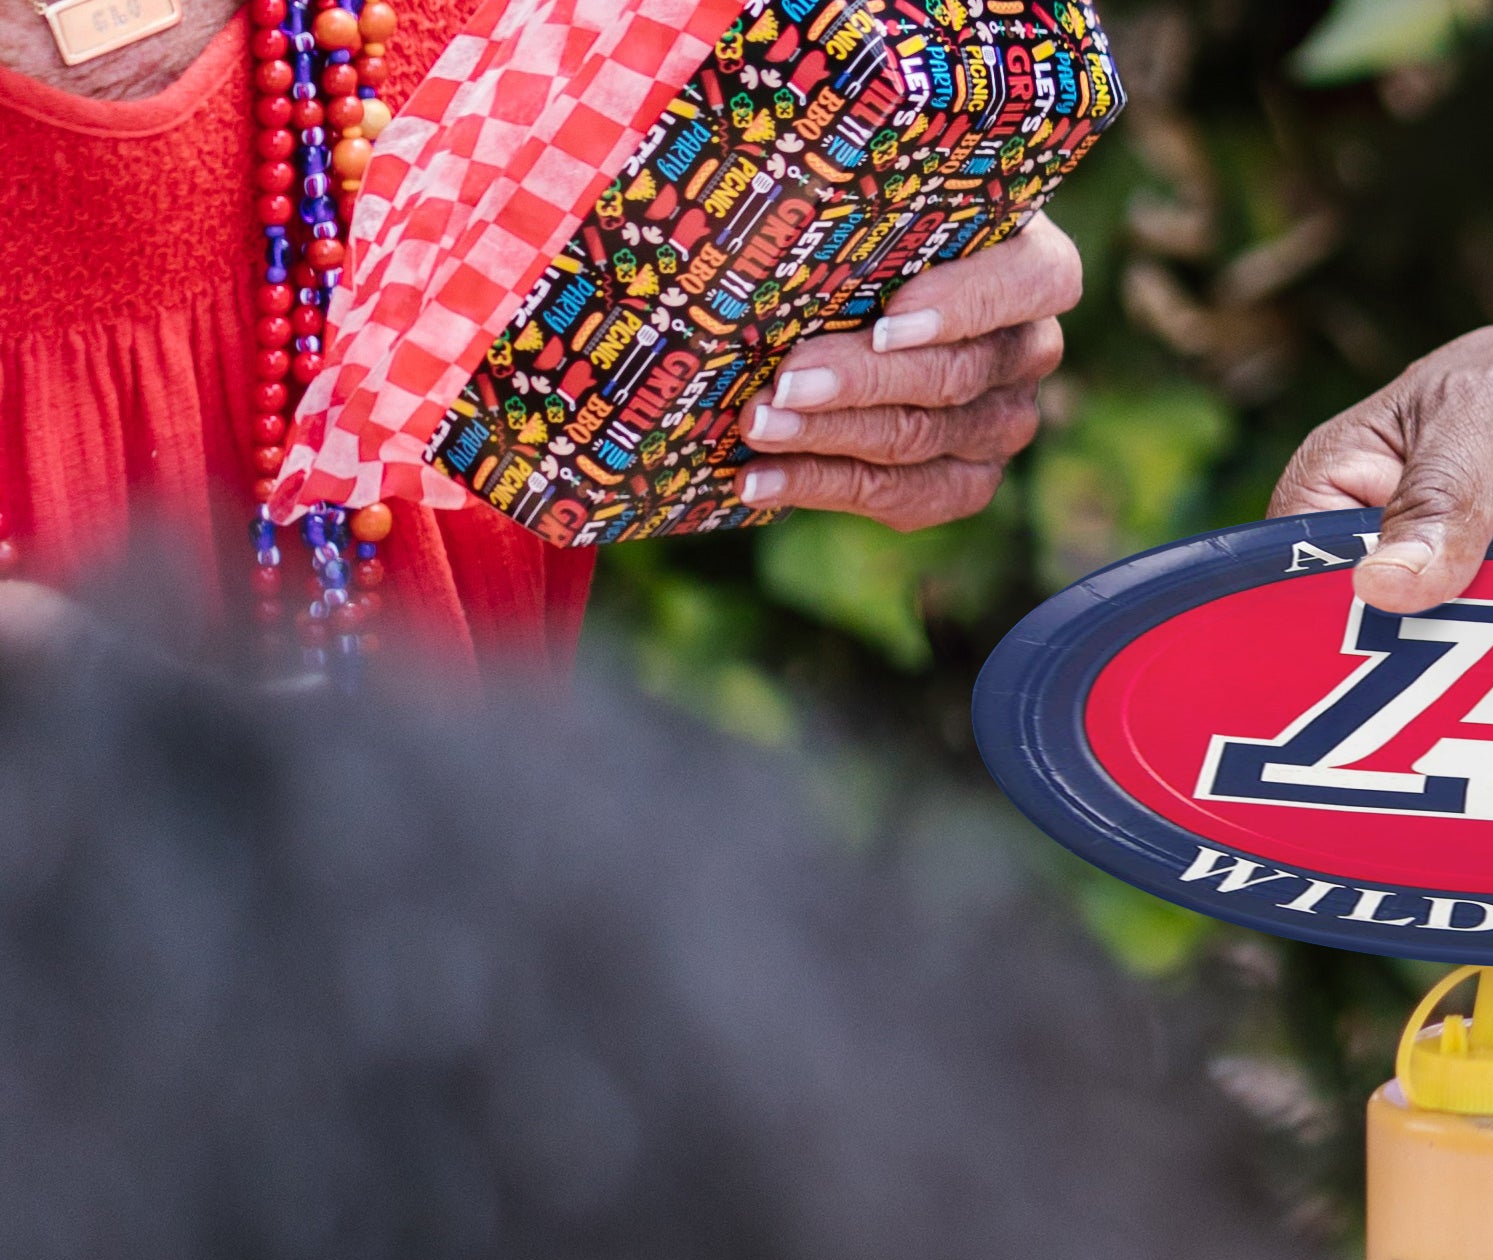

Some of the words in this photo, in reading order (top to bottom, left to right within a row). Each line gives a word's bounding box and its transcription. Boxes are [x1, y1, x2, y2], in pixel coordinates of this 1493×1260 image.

[826, 8, 875, 60] ICNIC
[892, 57, 930, 127] LET'S
[966, 45, 988, 112] PICNIC
[1021, 61, 1054, 133] LET'S
[1087, 53, 1111, 118] PICNIC
[792, 85, 846, 140] BBQ
[938, 131, 983, 174] BBQ
[704, 156, 758, 218] PICNIC
[775, 220, 833, 278] LET'S
[851, 212, 900, 262] PICNIC
[901, 222, 957, 276] LET'S
[675, 241, 728, 294] BBQ
[590, 309, 643, 370] PICNIC
[563, 392, 614, 444] BBQ
[661, 370, 717, 428] LET'S
[489, 455, 533, 511] PICNIC
